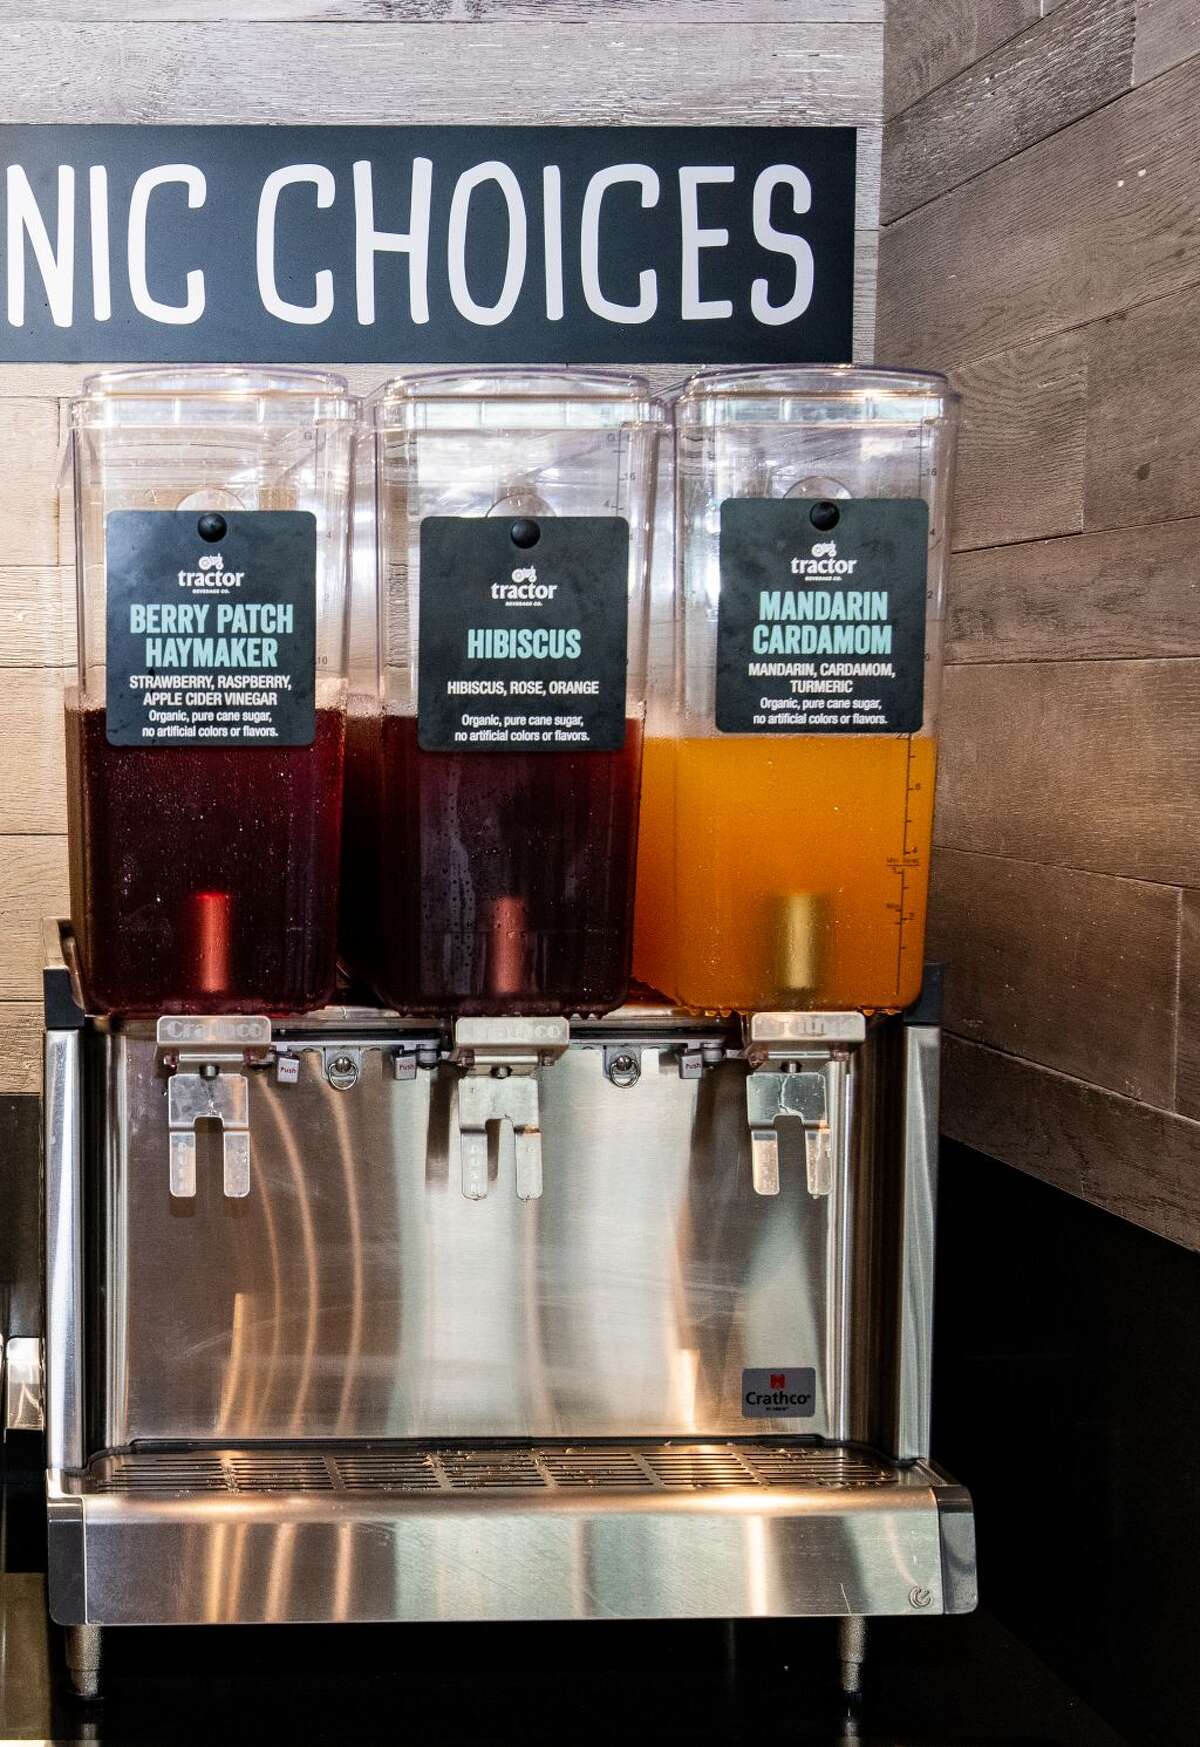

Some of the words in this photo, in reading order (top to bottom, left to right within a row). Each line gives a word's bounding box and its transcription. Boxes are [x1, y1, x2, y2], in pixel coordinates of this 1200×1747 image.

[256, 157, 815, 326] CHOICES
[791, 557, 857, 574] tractor
[178, 570, 245, 587] tractor
[491, 582, 558, 599] tractor
[759, 591, 888, 621] MANDARIN
[130, 603, 210, 634] BERRY
[217, 604, 293, 634] PATCH
[468, 629, 581, 659] HIBISCUS
[753, 624, 892, 654] CARDAMOM
[146, 638, 278, 667] HAYMAKER
[748, 663, 817, 678] MANDARIN,
[820, 663, 896, 678] CARDAMOM,
[129, 675, 215, 690] STRAWBERRY,
[218, 675, 292, 690] RASPBERRY,
[447, 681, 507, 696] HIBISCUS,
[510, 681, 546, 696] ROSE,
[549, 681, 599, 694] ORANGE
[790, 680, 853, 693] TURMERIC
[143, 692, 183, 706] APPLE
[185, 692, 222, 706] CIDER
[224, 692, 277, 706] VINEGAR
[760, 697, 801, 711] Organic,
[802, 699, 825, 711] pure
[826, 699, 851, 709] cane
[852, 699, 882, 711] sugar,
[149, 709, 190, 723] Organic,
[191, 712, 214, 723] pure
[216, 712, 240, 721] cane
[242, 711, 272, 723] sugar,
[461, 714, 502, 728] Organic,
[504, 716, 527, 728] pure
[528, 716, 553, 726] cane
[554, 716, 584, 728] sugar,
[753, 715, 766, 724] no
[767, 713, 807, 724] artificial
[808, 713, 838, 724] colors
[840, 715, 851, 724] or
[852, 713, 888, 724] flavors.
[142, 727, 155, 737] no
[157, 725, 196, 737] artificial
[198, 725, 228, 737] colors
[230, 727, 241, 737] or
[242, 725, 279, 737] flavors.
[455, 732, 468, 741] no
[469, 729, 508, 741] artificial
[510, 730, 540, 741] colors
[542, 732, 553, 741] or
[554, 729, 590, 741] flavors.
[280, 1066, 297, 1074] Push
[400, 1063, 415, 1071] Push
[745, 1391, 808, 1405] Crathco
